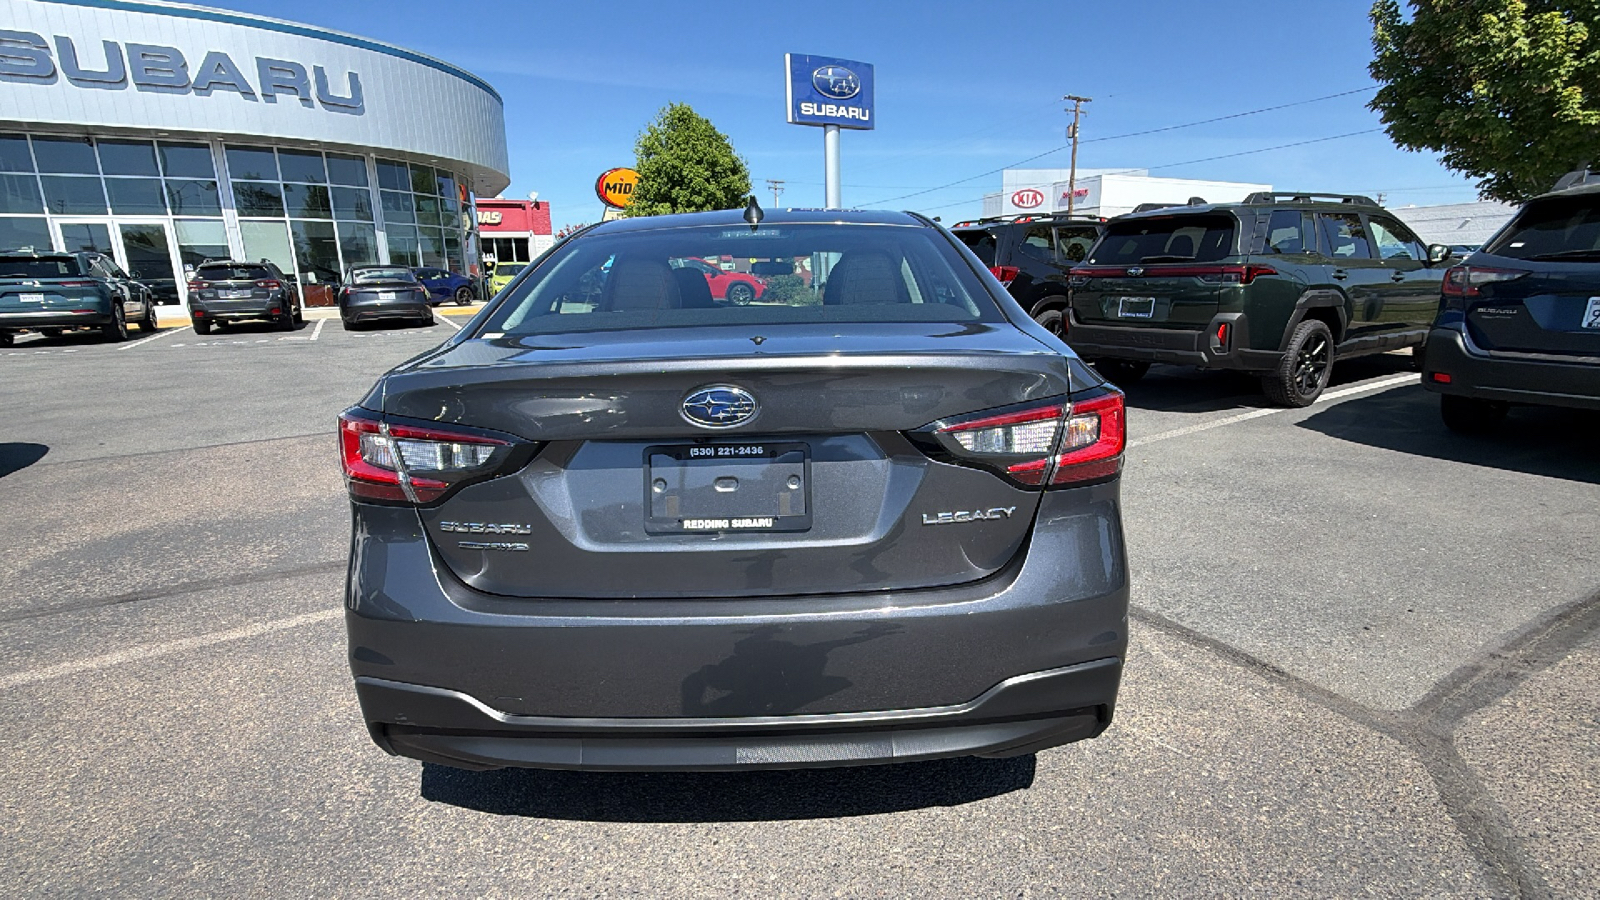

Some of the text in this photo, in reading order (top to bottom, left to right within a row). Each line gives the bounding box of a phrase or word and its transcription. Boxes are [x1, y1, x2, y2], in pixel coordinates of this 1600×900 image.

[0, 29, 364, 110] SUBARU
[801, 103, 869, 120] SUBARU
[604, 182, 633, 194] MID
[1017, 192, 1039, 205] KIA
[1477, 307, 1518, 315] SUBARU
[690, 447, 715, 457] (530)
[922, 506, 1016, 525] LEGACY
[440, 521, 531, 534] SUBARU
[683, 518, 773, 529] REDDING SUBARU
